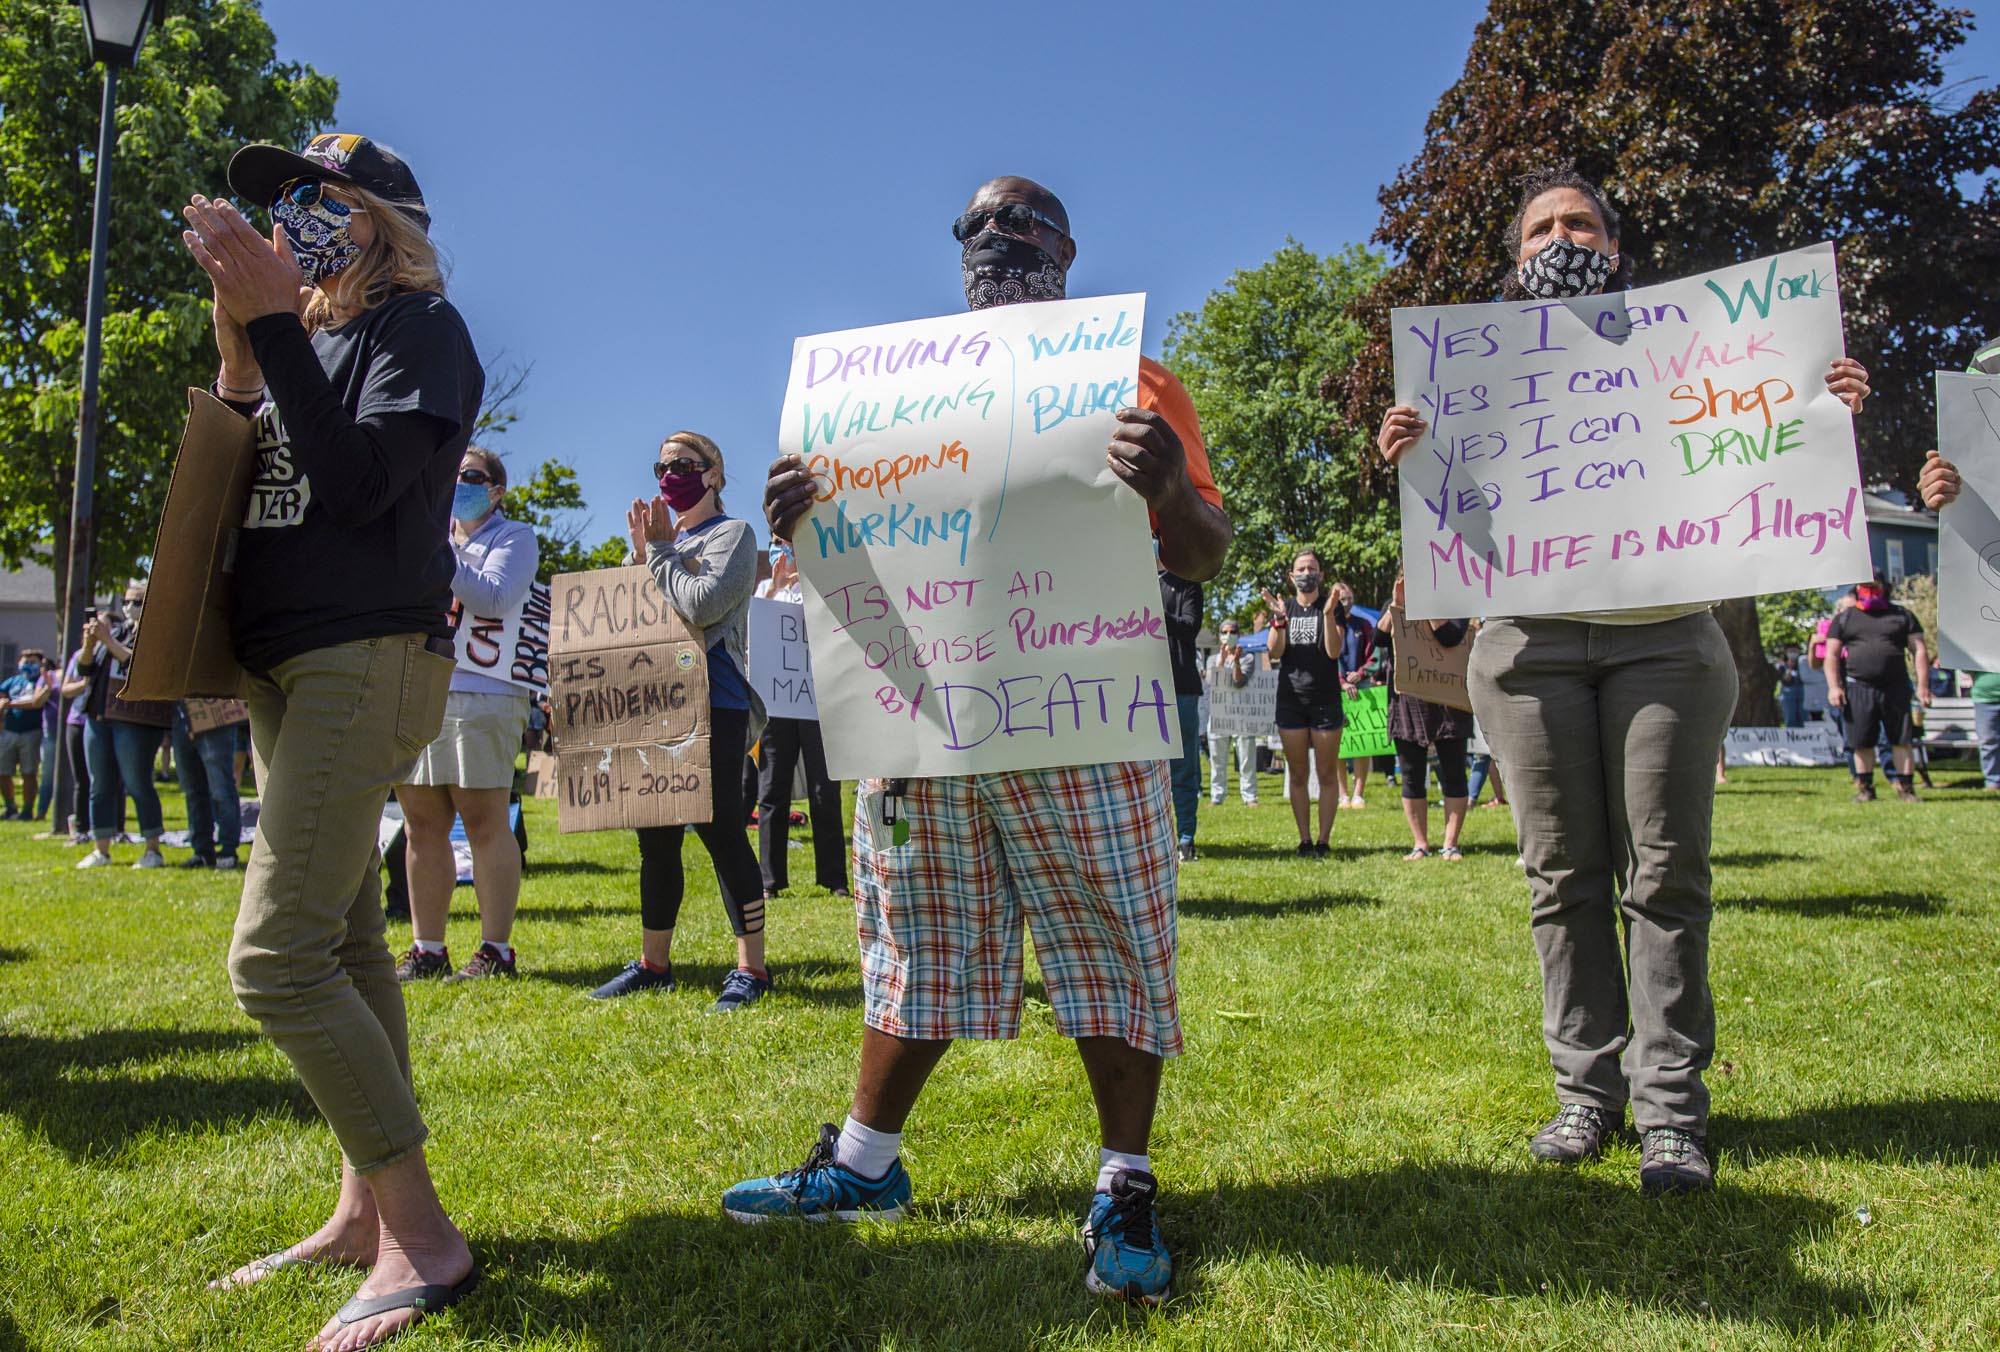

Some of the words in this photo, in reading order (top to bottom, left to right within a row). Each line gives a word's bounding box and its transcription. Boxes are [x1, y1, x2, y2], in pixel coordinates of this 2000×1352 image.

[805, 330, 991, 389] DRIVING
[1409, 317, 1500, 383] YES
[1519, 303, 1569, 355] I
[1595, 303, 1688, 338] can
[802, 377, 996, 454] WALKING
[1025, 375, 1137, 434] BLACK
[1420, 383, 1490, 440] YES
[1508, 370, 1554, 409] I
[1567, 366, 1639, 393] can
[1644, 330, 1786, 384] WALK
[1423, 482, 1502, 532] YES
[1525, 466, 1566, 502] I
[1574, 459, 1646, 490] can
[1670, 418, 1806, 477] DRIVE
[1432, 434, 1508, 497] YES
[1519, 413, 1561, 459] I
[1568, 411, 1641, 444] can
[1505, 533, 1596, 577] LIFE
[1611, 529, 1646, 561] IS
[1655, 513, 1731, 553] NOT
[1727, 481, 1858, 555] Illegal
[823, 581, 890, 633] IS
[906, 578, 985, 613] NOT
[560, 656, 606, 684] IS
[628, 650, 654, 671] A
[565, 682, 686, 731] PANDEMIC
[874, 682, 925, 723] BY
[933, 672, 1177, 751] DEATH
